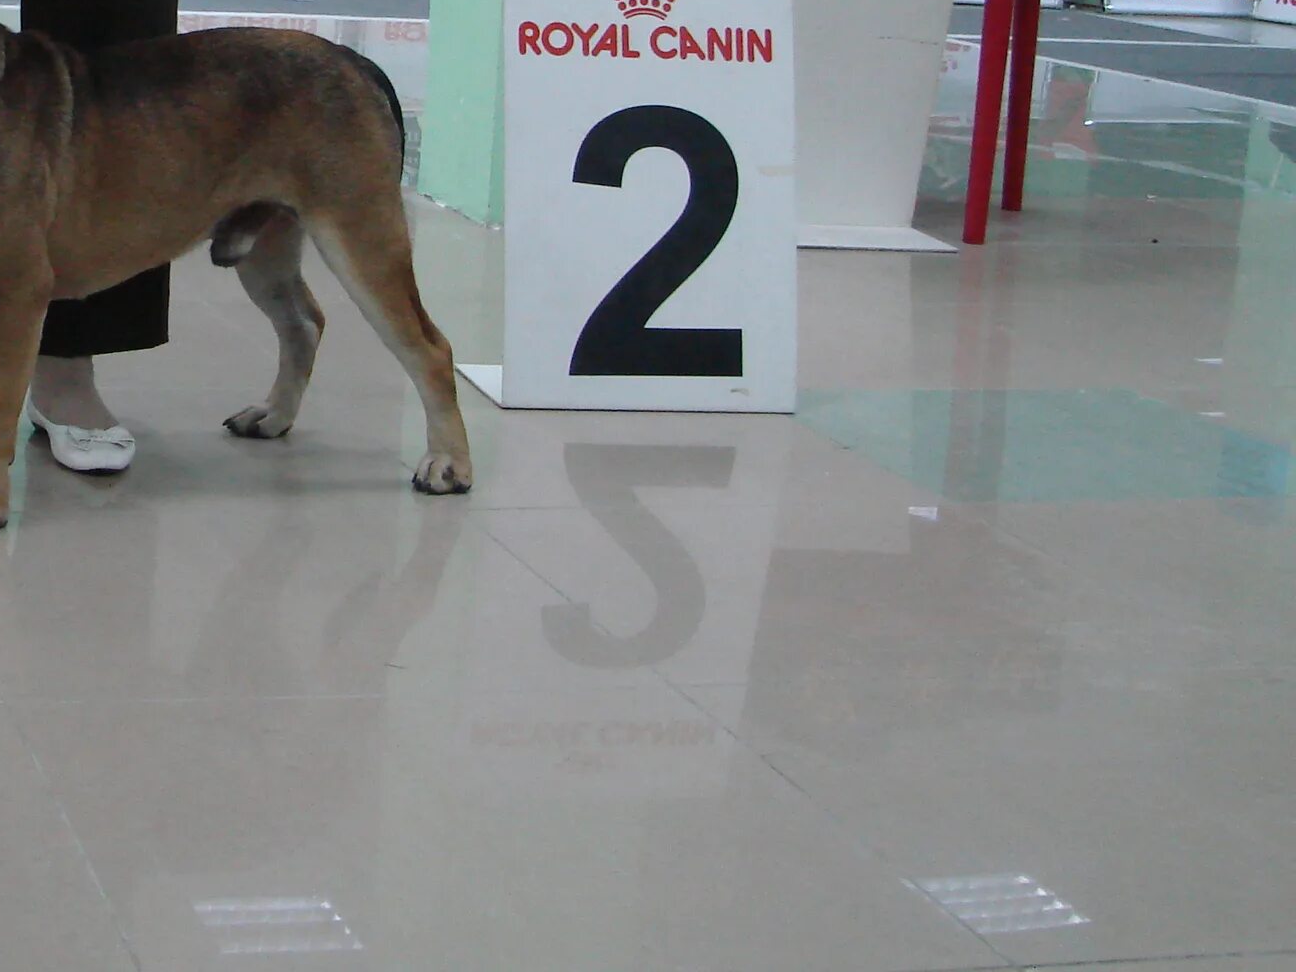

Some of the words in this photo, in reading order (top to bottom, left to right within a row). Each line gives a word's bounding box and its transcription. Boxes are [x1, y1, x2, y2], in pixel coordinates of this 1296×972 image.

[517, 21, 642, 59] ROYAL
[649, 25, 774, 64] CANIN
[568, 104, 744, 377] 2
